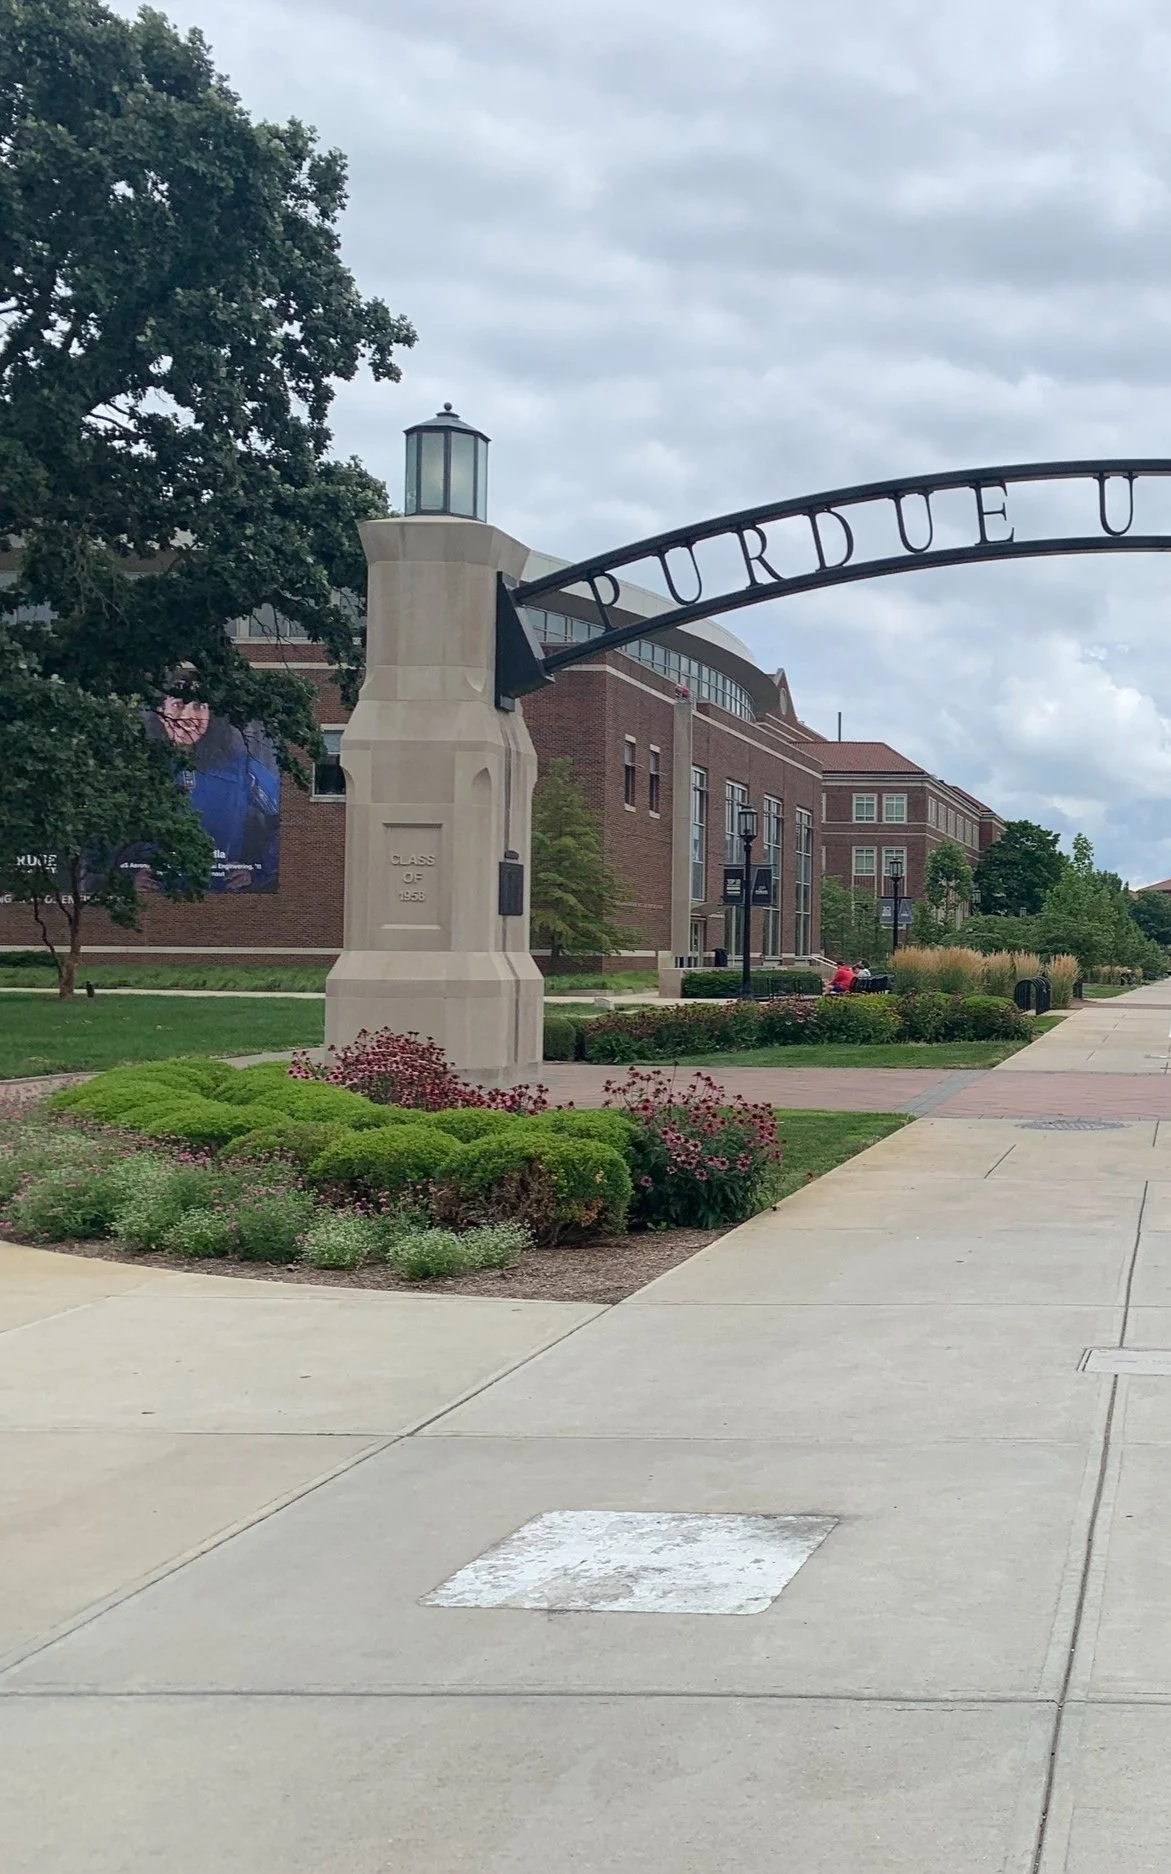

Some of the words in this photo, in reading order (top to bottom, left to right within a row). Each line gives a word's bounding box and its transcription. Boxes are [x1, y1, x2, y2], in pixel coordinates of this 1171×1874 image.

[583, 480, 1015, 630] PURDUE
[391, 854, 436, 866] CLASS
[402, 872, 424, 884] OF
[399, 890, 426, 903] 1958
